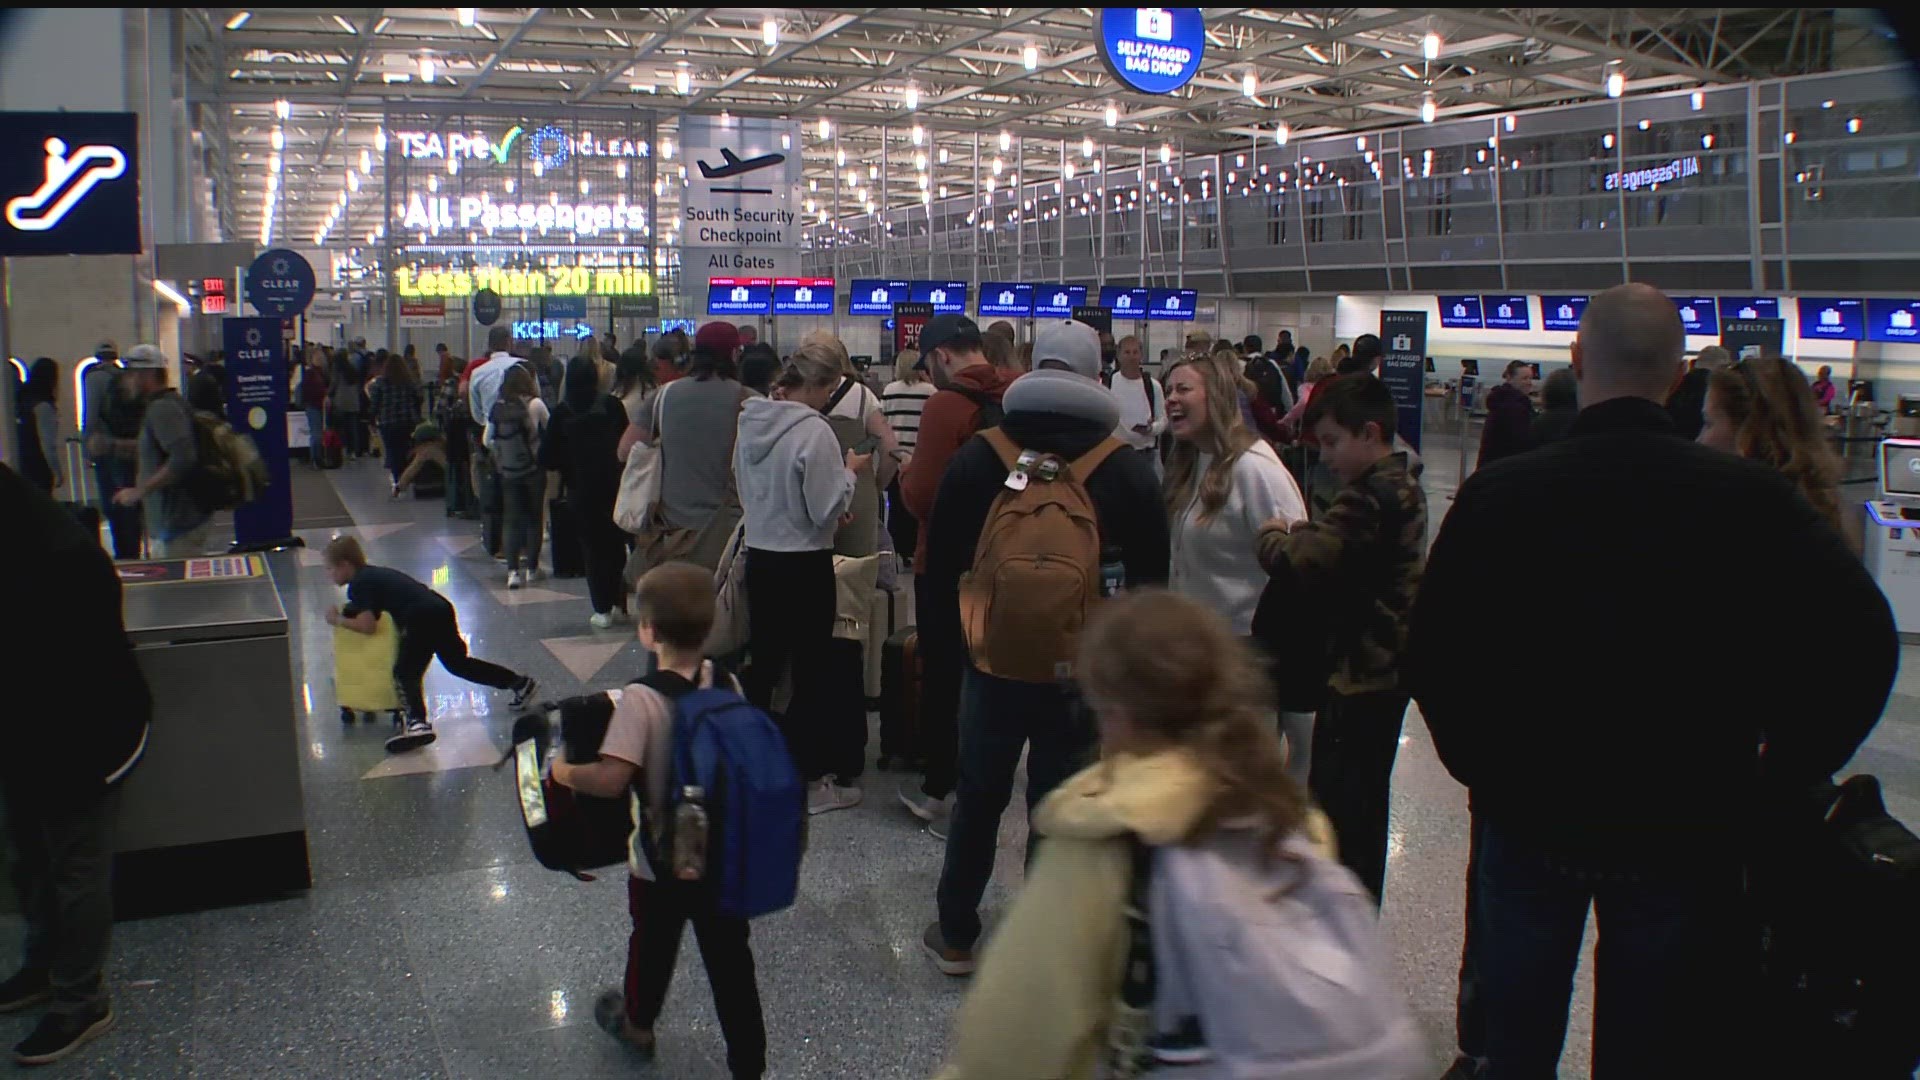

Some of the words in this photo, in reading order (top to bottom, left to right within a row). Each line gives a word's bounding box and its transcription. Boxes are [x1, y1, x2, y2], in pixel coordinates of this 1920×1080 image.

[1117, 40, 1191, 63] SELF-TAGGED
[1126, 57, 1150, 73] BAG
[1151, 60, 1183, 76] DROP
[396, 132, 444, 158] TSA
[450, 133, 490, 158] Pre
[580, 139, 649, 157] CLEAR
[404, 193, 453, 228] All
[460, 197, 646, 235] Passengers
[686, 207, 729, 220] South
[734, 208, 795, 225] Security
[700, 227, 781, 245] Checkpoint
[708, 254, 729, 268] All
[733, 254, 775, 269] Gates
[204, 279, 223, 291] EXIT
[262, 279, 299, 289] CLEAR
[399, 267, 472, 295] Less
[478, 267, 546, 295] than
[554, 266, 589, 295] 20
[596, 268, 651, 295] min
[206, 295, 225, 311] EXIT
[512, 320, 560, 339] KCM
[238, 349, 270, 359] CLEAR
